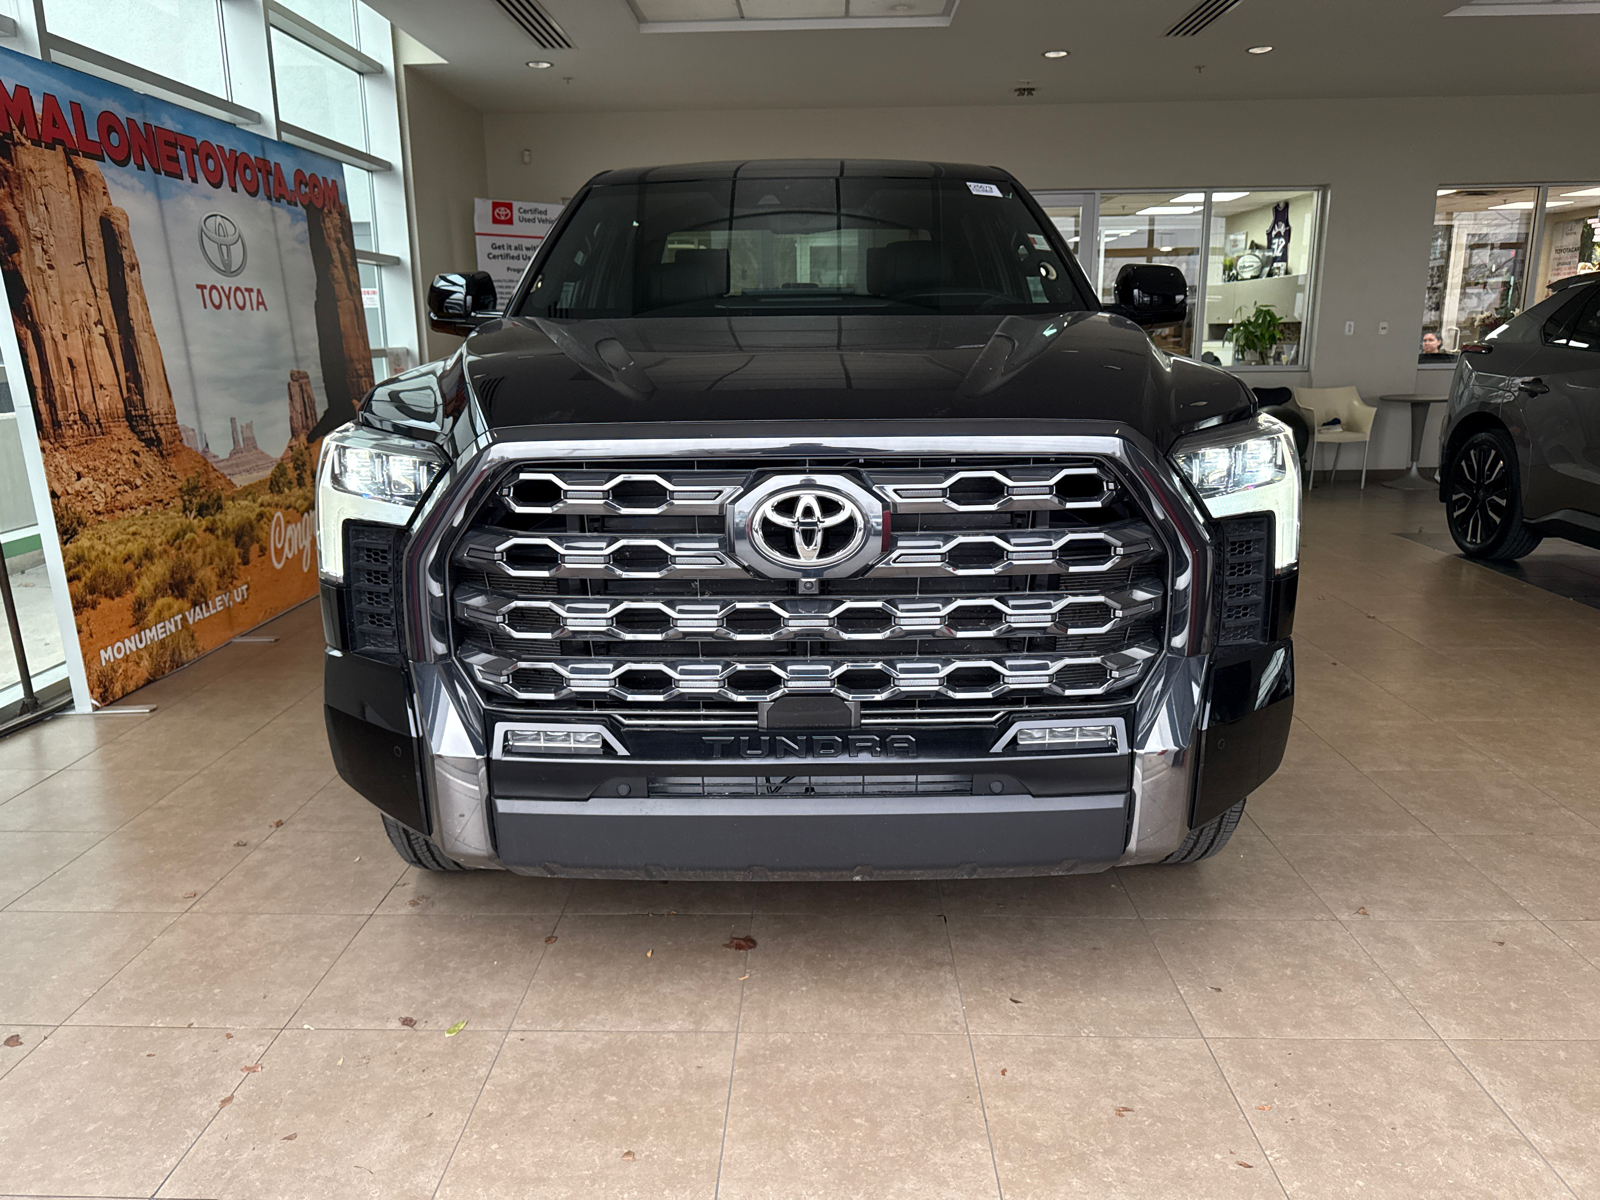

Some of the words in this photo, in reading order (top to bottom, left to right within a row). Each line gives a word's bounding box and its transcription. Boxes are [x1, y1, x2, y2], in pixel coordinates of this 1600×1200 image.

[0, 79, 341, 211] MALONETOYOTA.COM
[518, 207, 547, 216] Certified
[518, 216, 536, 224] Used
[491, 243, 505, 251] Get
[506, 243, 512, 251] it
[514, 244, 523, 252] all
[487, 253, 521, 261] Certified
[195, 283, 268, 313] TOYOTA
[99, 613, 183, 667] MONUMENT
[185, 592, 233, 626] VALLEY,
[233, 584, 249, 603] UT
[701, 734, 918, 759] TUNDRA
